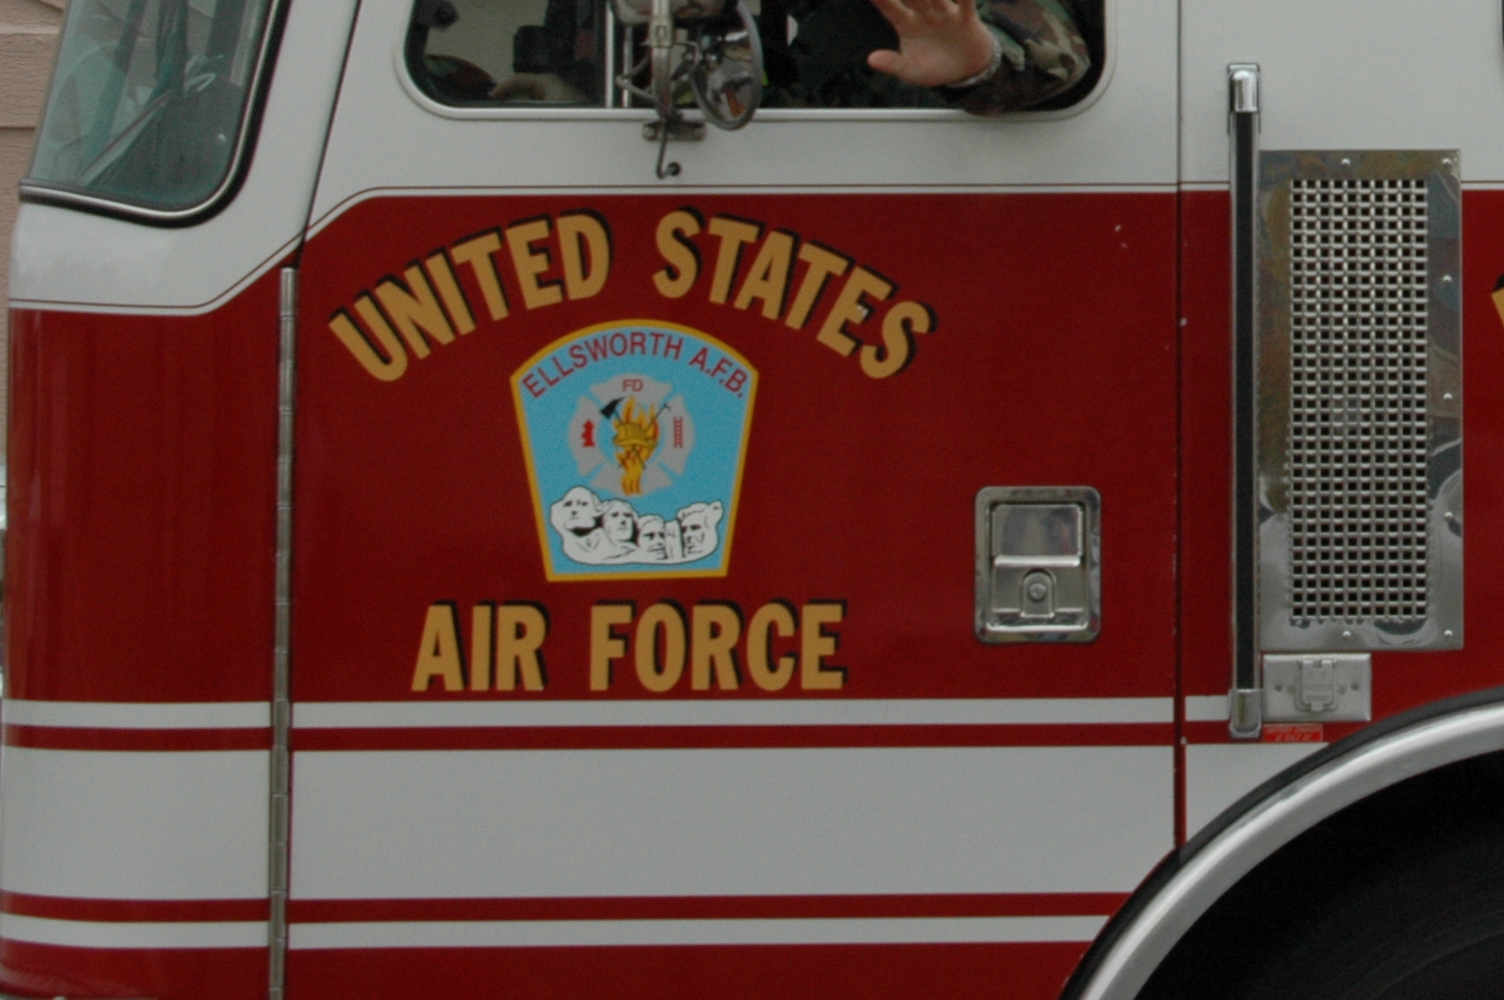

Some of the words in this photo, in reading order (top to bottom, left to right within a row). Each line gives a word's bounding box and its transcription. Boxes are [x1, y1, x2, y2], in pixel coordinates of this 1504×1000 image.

[328, 211, 611, 382] UNITED
[652, 208, 933, 379] STATES
[521, 331, 682, 398] ELLSWORTH
[689, 346, 748, 398] A.F.B.
[622, 379, 644, 392] FD
[411, 603, 547, 692] AIR
[590, 602, 845, 692] FORCE
